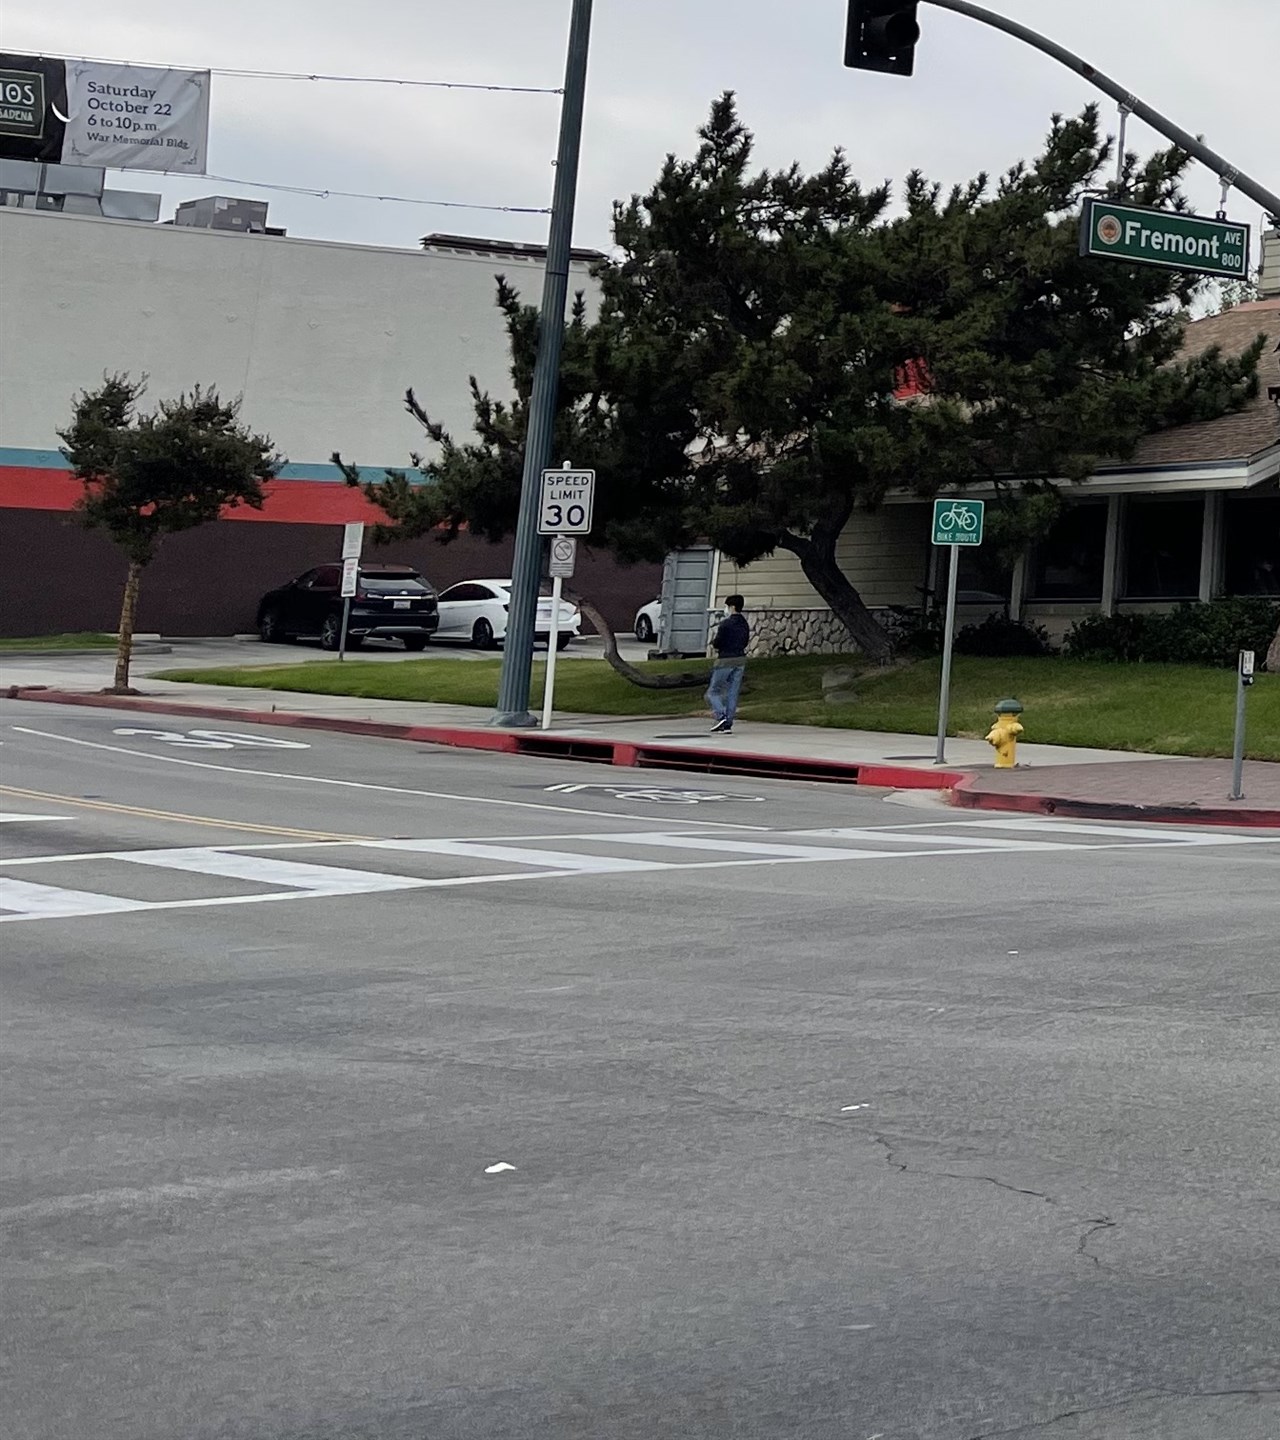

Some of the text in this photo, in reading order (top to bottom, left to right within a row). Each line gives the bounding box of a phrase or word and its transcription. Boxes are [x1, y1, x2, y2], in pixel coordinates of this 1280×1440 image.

[87, 81, 157, 101] Saturday
[87, 97, 172, 116] October 22
[87, 114, 97, 126] 6
[100, 117, 113, 128] to
[87, 132, 110, 142] War
[112, 133, 164, 147] Memorial
[1124, 221, 1242, 259] Fremont AVE
[1221, 253, 1241, 268] 800
[547, 476, 590, 486] SPEED
[550, 489, 585, 500] LIMIT
[545, 504, 585, 527] 30
[936, 532, 978, 543] BIKE ROUTE
